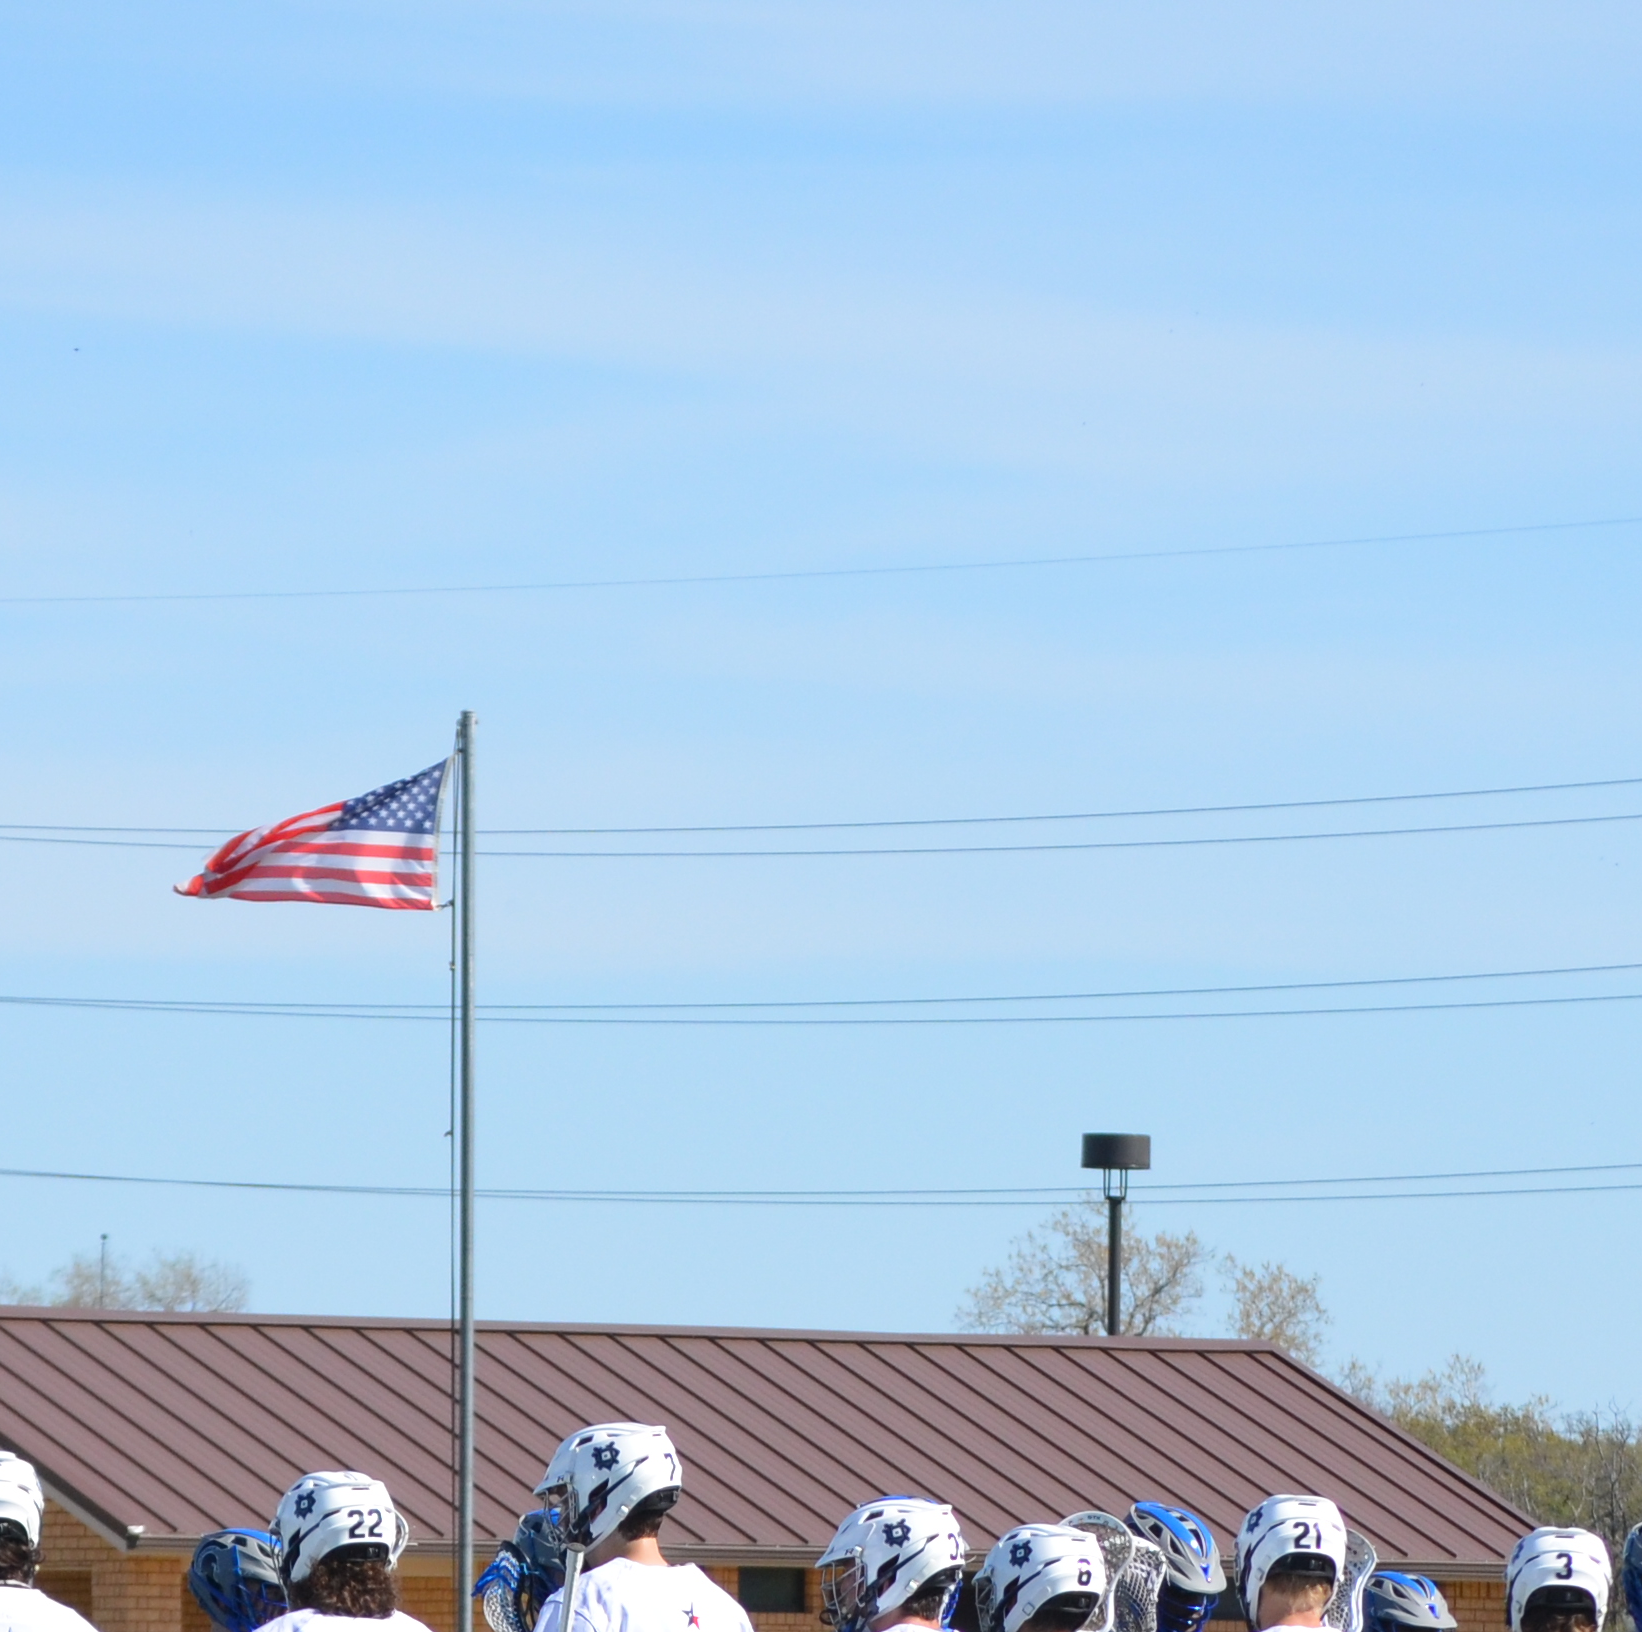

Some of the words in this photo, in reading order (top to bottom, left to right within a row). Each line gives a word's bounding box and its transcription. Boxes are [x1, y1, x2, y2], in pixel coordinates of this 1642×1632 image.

[663, 1453, 676, 1481] 7
[347, 1508, 383, 1539] 22
[1293, 1521, 1322, 1550] 21
[1077, 1558, 1092, 1587] 6
[1555, 1552, 1573, 1580] 3
